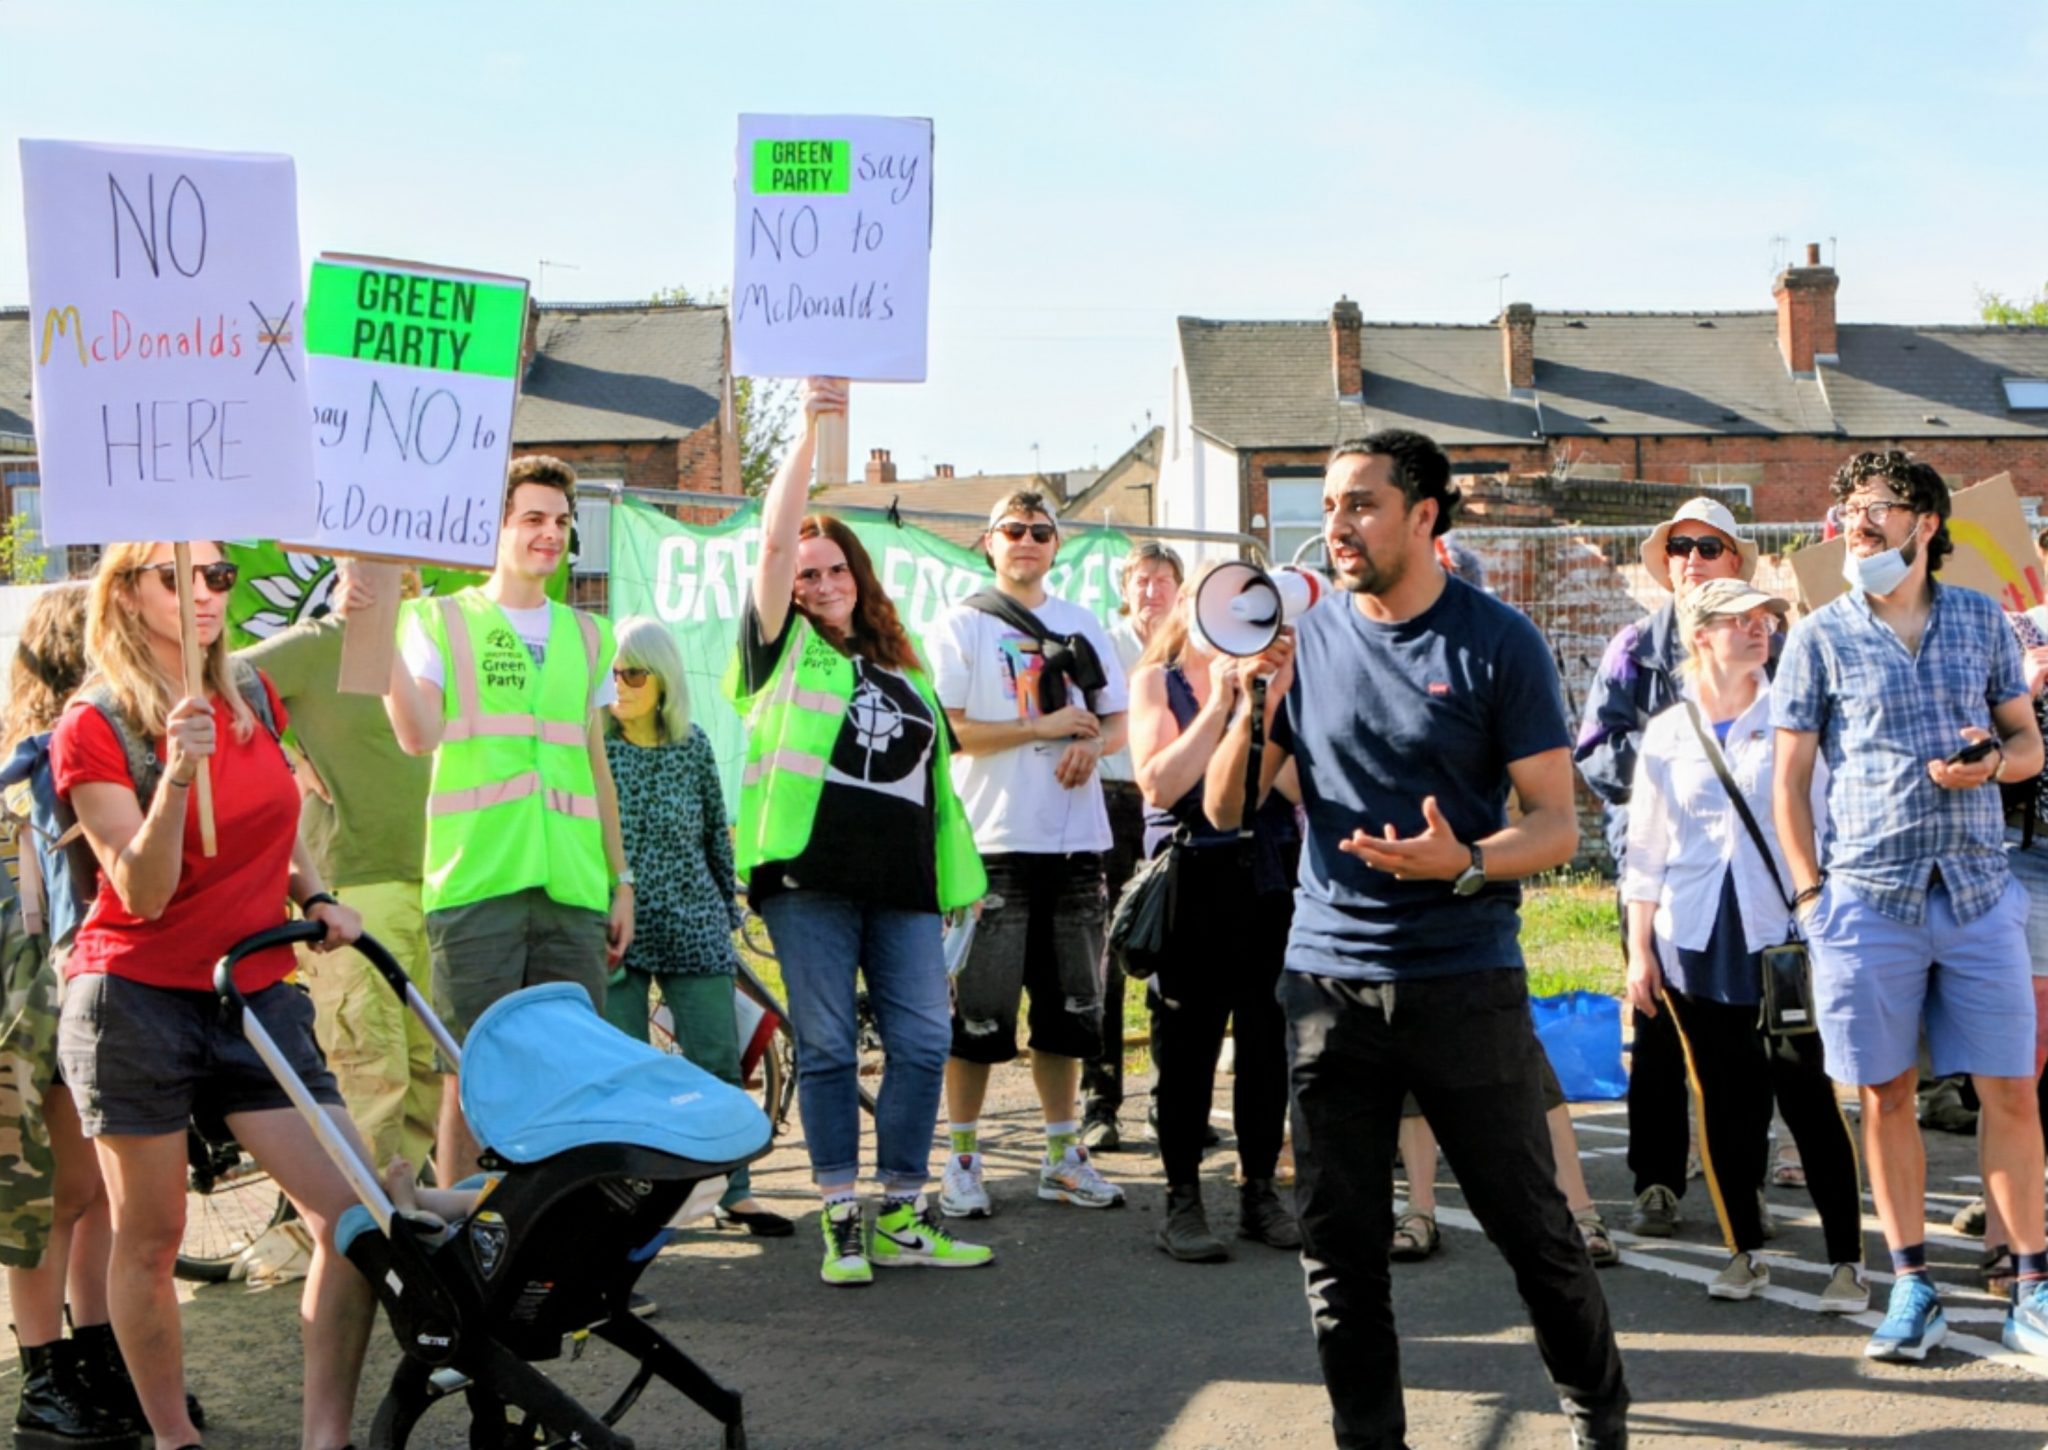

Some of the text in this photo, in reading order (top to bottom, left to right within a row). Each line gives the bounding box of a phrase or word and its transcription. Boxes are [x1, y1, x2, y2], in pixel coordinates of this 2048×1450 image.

[772, 141, 833, 164] GREEN
[772, 168, 832, 191] PARTY
[857, 153, 919, 205] say
[108, 171, 207, 279] NO
[750, 205, 884, 262] NO to
[356, 270, 477, 324] GREEN
[738, 280, 894, 326] McDonald's
[38, 304, 242, 368] McDonald's
[352, 317, 472, 371] PARTY
[102, 398, 252, 487] HERE
[363, 379, 461, 465] NO
[472, 414, 496, 449] to
[482, 659, 527, 672] Green
[486, 673, 526, 690] Party
